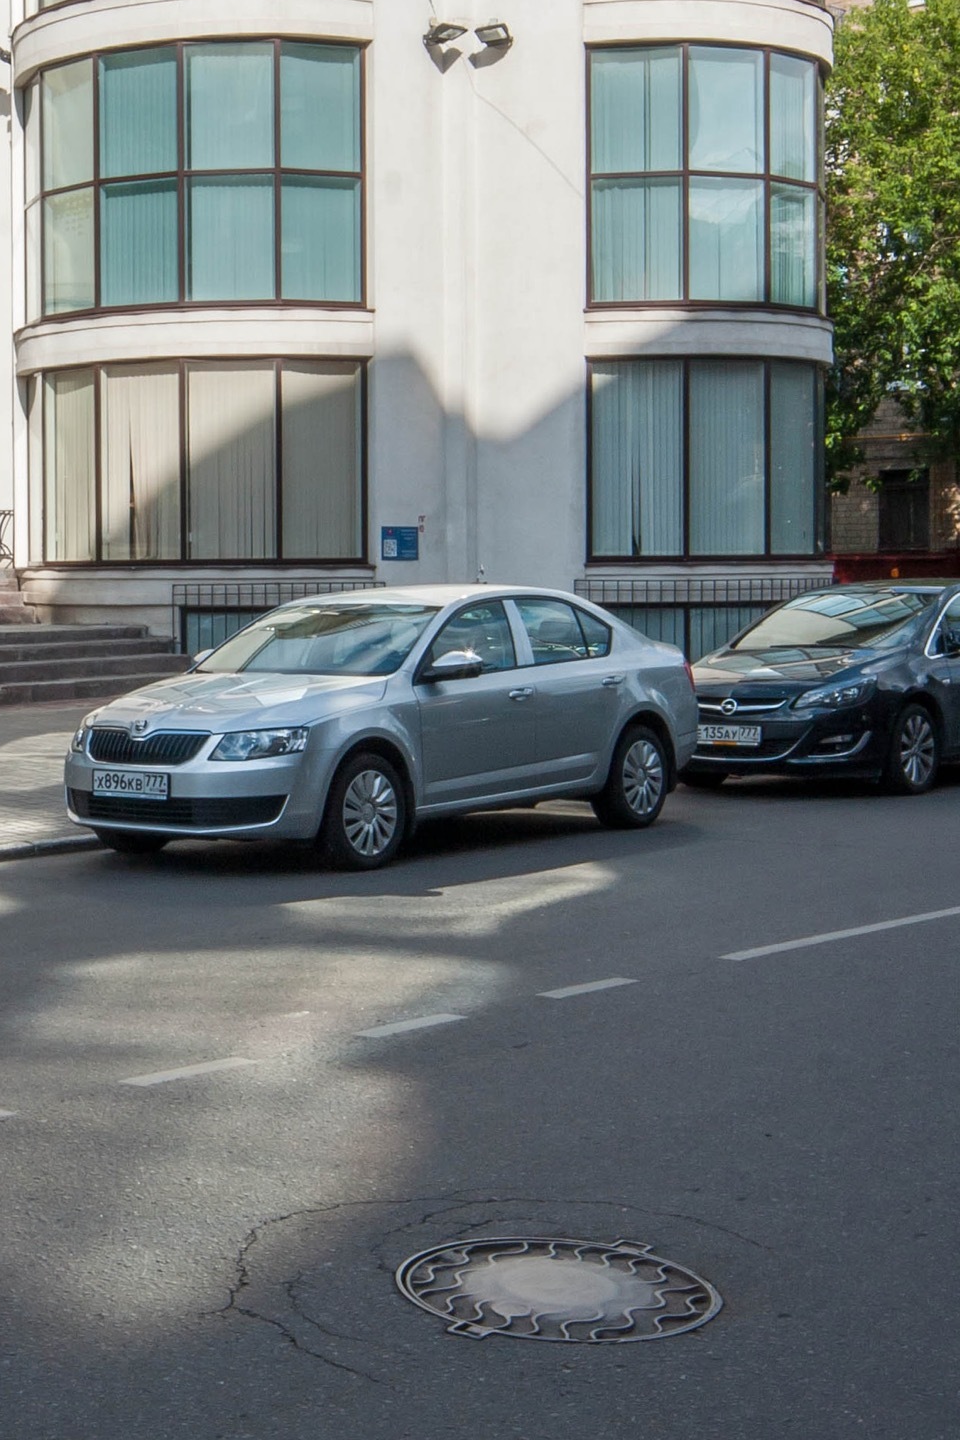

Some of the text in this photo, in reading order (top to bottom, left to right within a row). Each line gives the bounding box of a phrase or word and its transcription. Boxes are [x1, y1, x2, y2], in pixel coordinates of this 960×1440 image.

[740, 727, 758, 737] 777
[97, 773, 164, 791] Х896КВ 777
